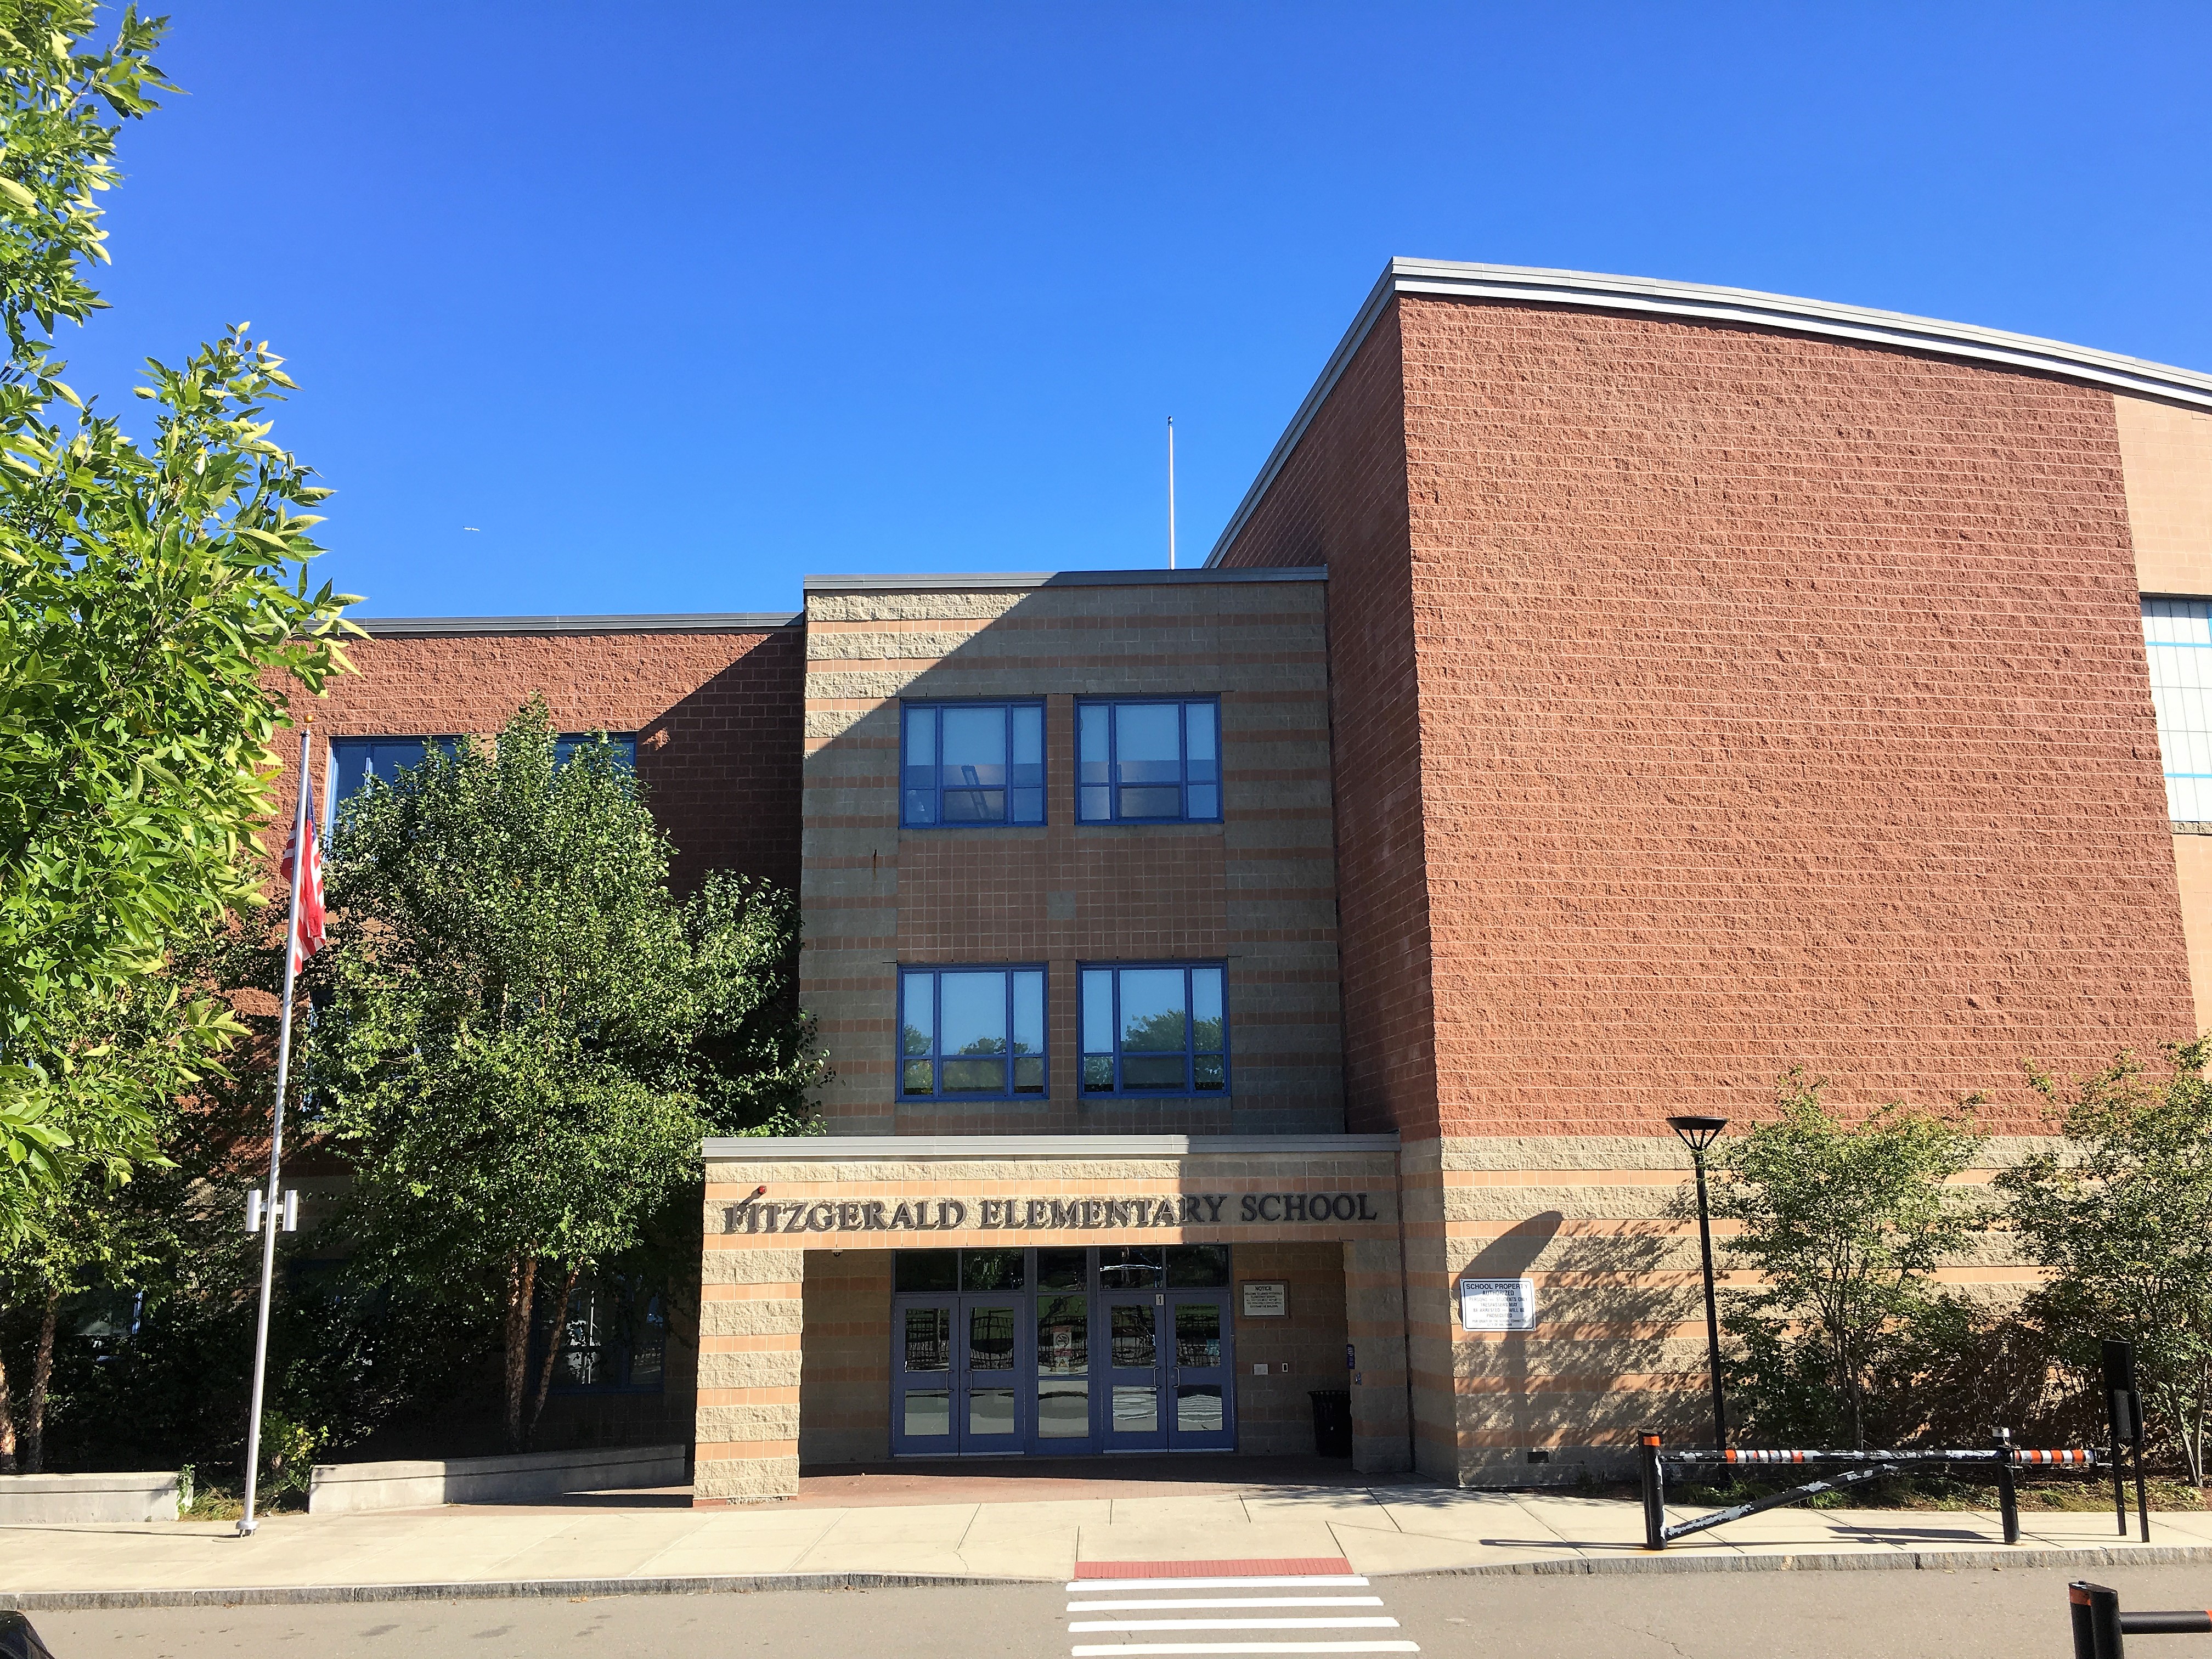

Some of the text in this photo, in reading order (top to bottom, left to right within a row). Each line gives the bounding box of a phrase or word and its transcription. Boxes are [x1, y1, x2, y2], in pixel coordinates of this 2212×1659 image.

[727, 1192, 1378, 1230] FITZGERALD ELEMENTARY SCHOOL
[1158, 1295, 1161, 1304] 1
